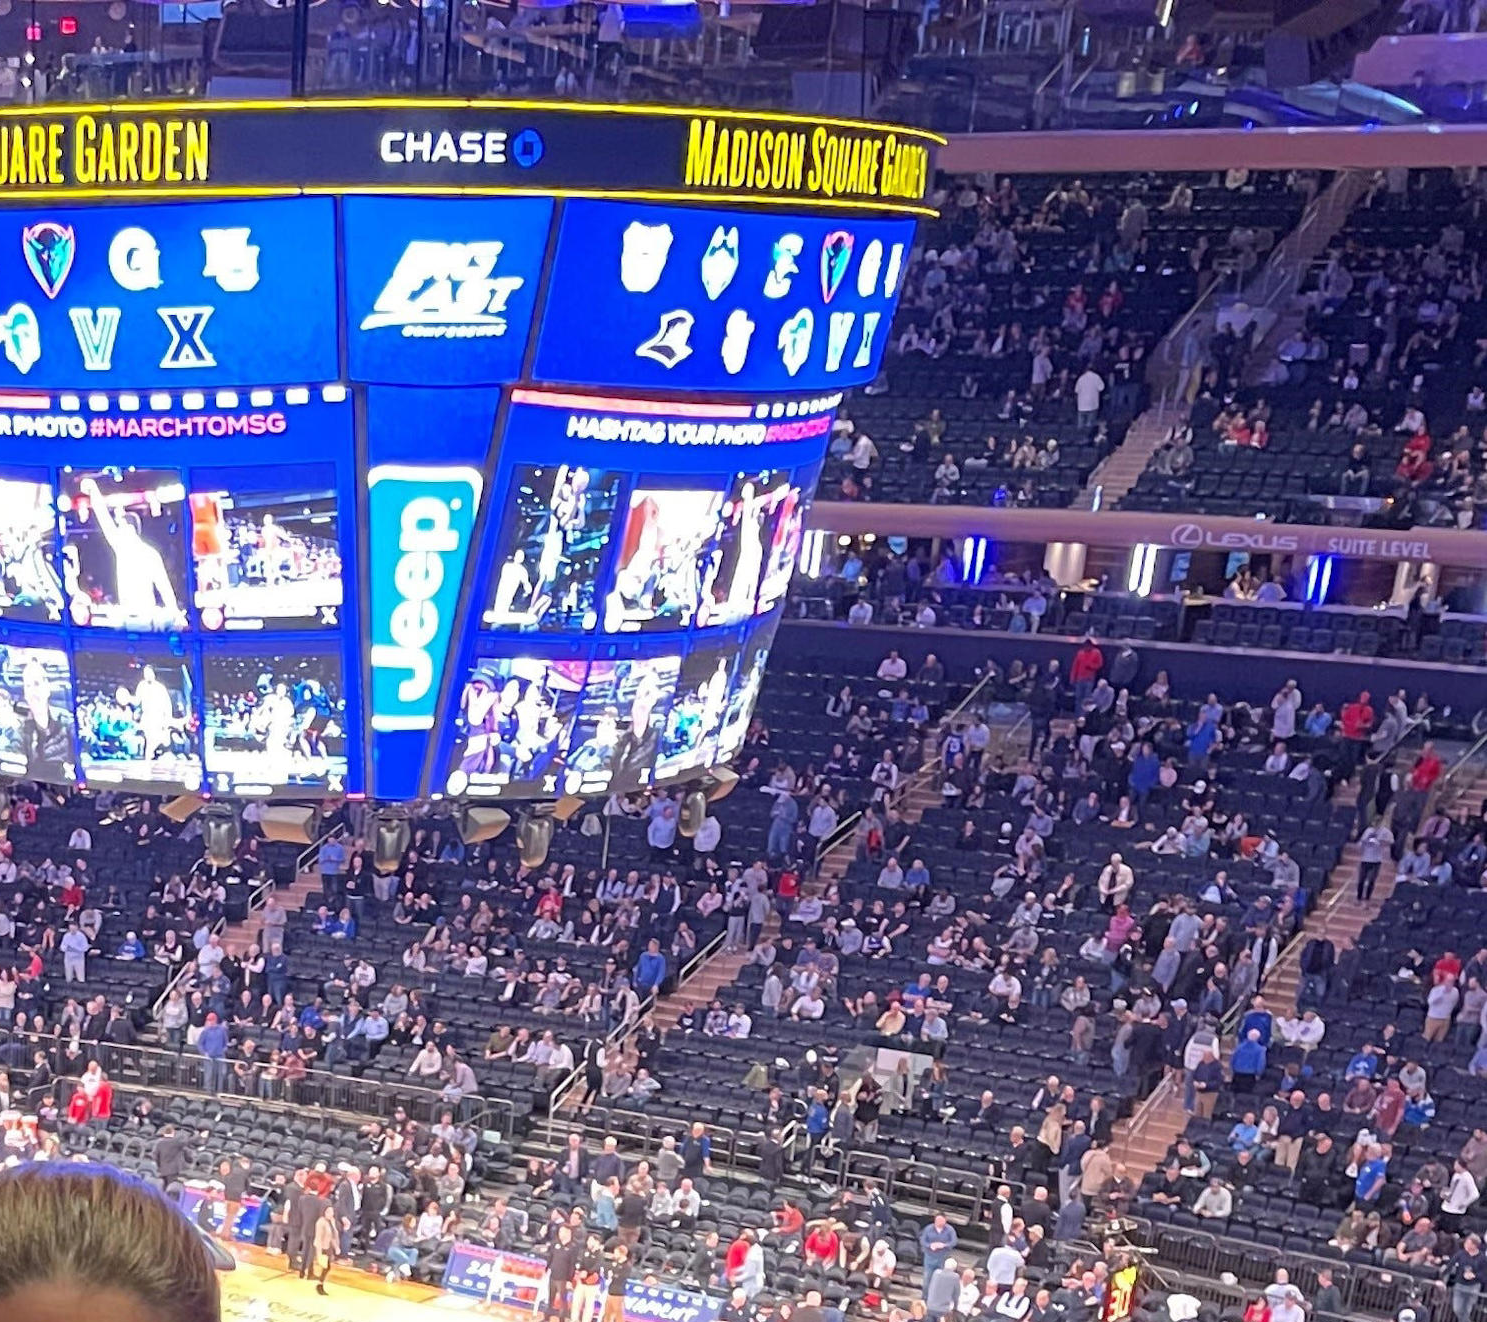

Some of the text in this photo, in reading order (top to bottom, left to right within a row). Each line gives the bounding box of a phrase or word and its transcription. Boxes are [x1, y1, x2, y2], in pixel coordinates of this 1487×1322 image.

[76, 115, 209, 184] GARDEN
[380, 131, 506, 164] CHASE
[685, 119, 806, 189] MADISON
[808, 127, 882, 197] SQUARE
[13, 415, 87, 439] PHOTO
[89, 413, 287, 440] #MARCHTOMSG
[1205, 533, 1298, 550] LEXUS
[1327, 537, 1432, 560] SUITE LEVEL
[371, 496, 460, 703] Jeep
[1107, 1289, 1132, 1322] 30
